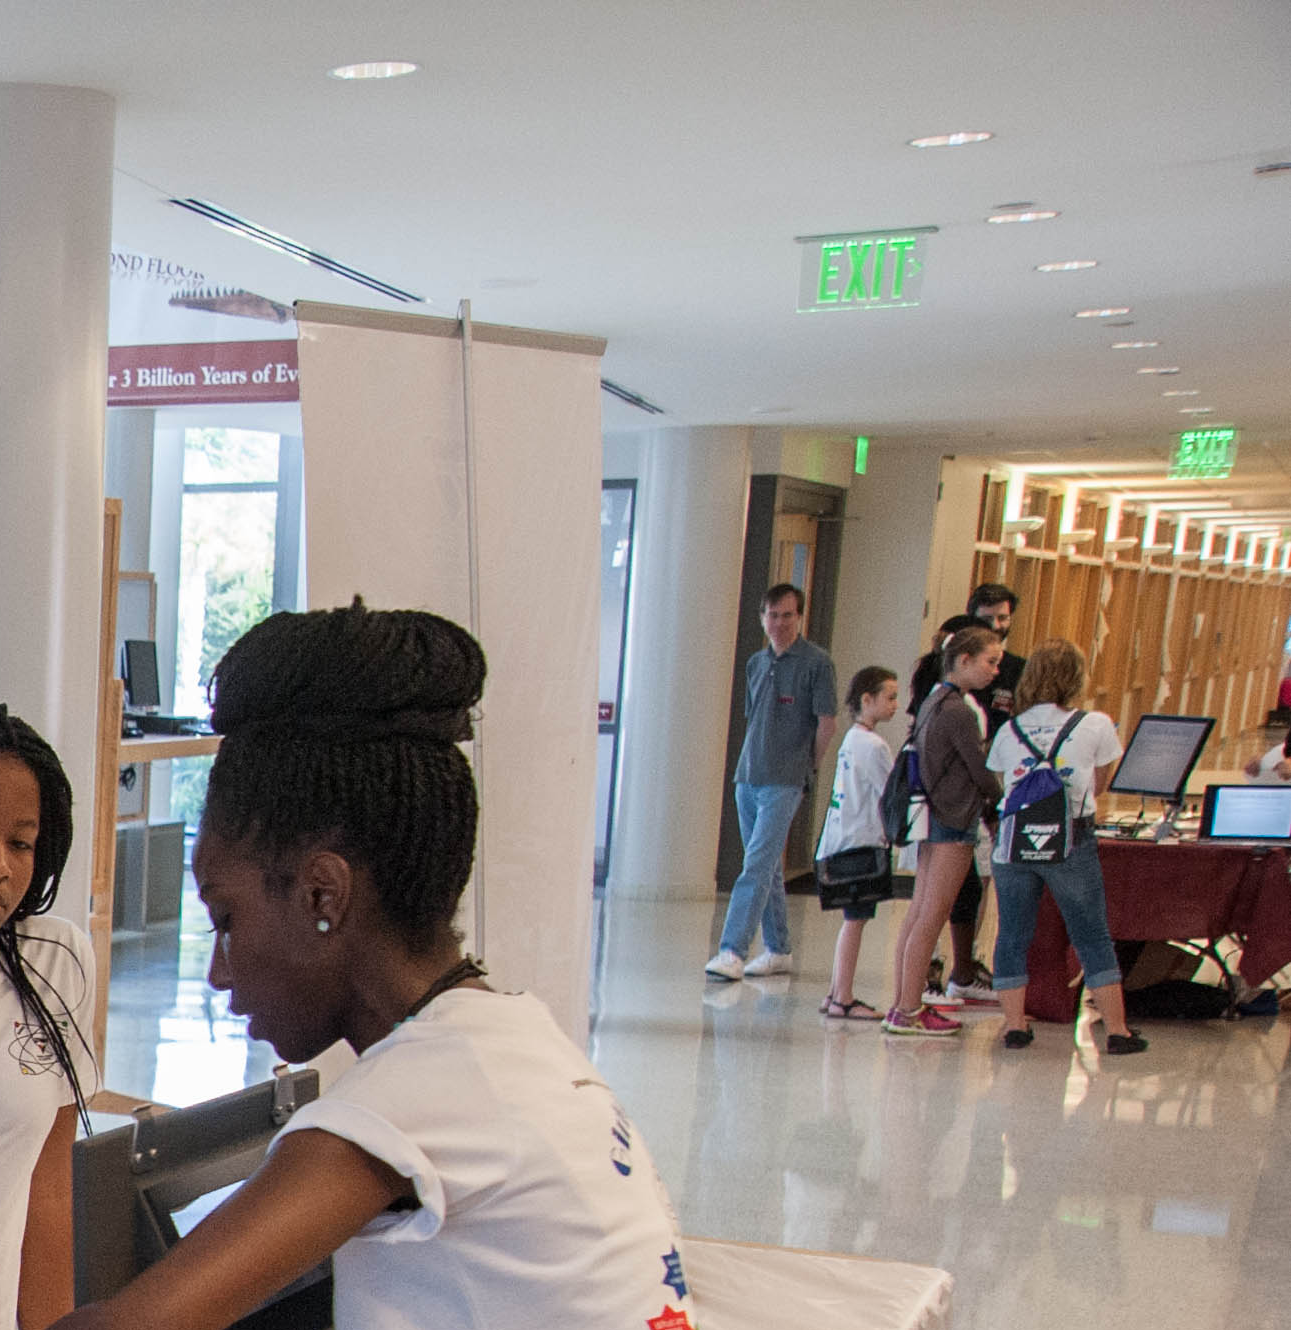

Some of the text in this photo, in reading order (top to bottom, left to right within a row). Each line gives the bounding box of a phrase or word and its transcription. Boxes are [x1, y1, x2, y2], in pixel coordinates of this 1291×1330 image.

[817, 237, 915, 304] EXIT
[120, 369, 132, 388] 3
[136, 366, 196, 387] Billion
[201, 364, 248, 386] Years
[252, 362, 273, 384] of
[274, 362, 301, 384] Ev
[1180, 430, 1234, 465] EXIT
